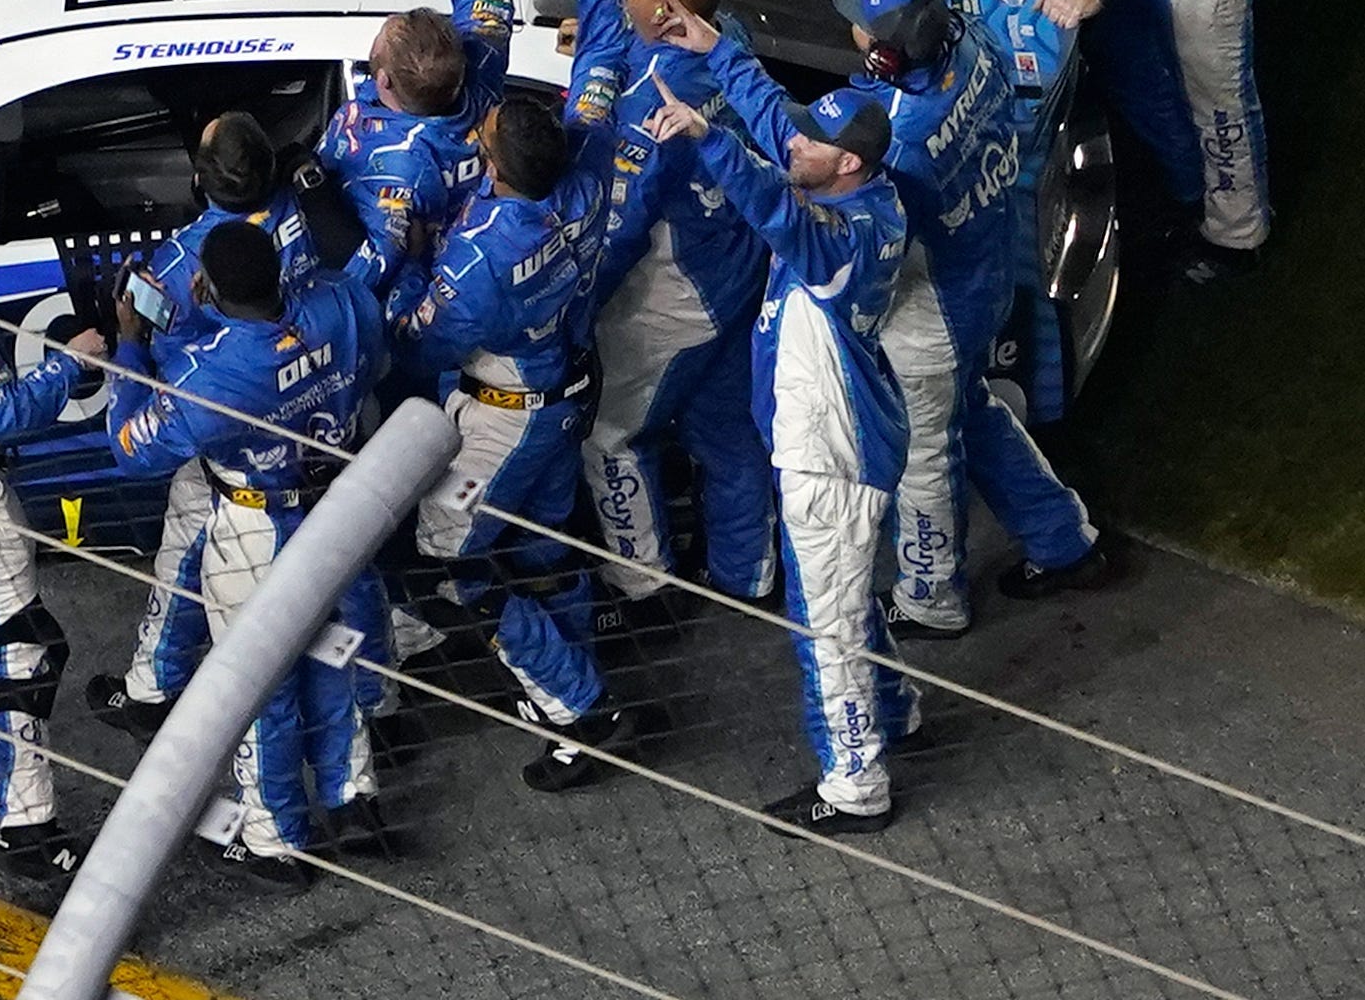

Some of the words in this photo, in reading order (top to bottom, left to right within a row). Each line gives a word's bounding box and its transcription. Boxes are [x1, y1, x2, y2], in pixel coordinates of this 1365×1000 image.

[112, 38, 276, 60] STENHOUSE
[925, 48, 993, 159] MYRICK
[975, 131, 1020, 208] Krog
[599, 455, 640, 531] Kroger
[903, 508, 949, 576] Kroger
